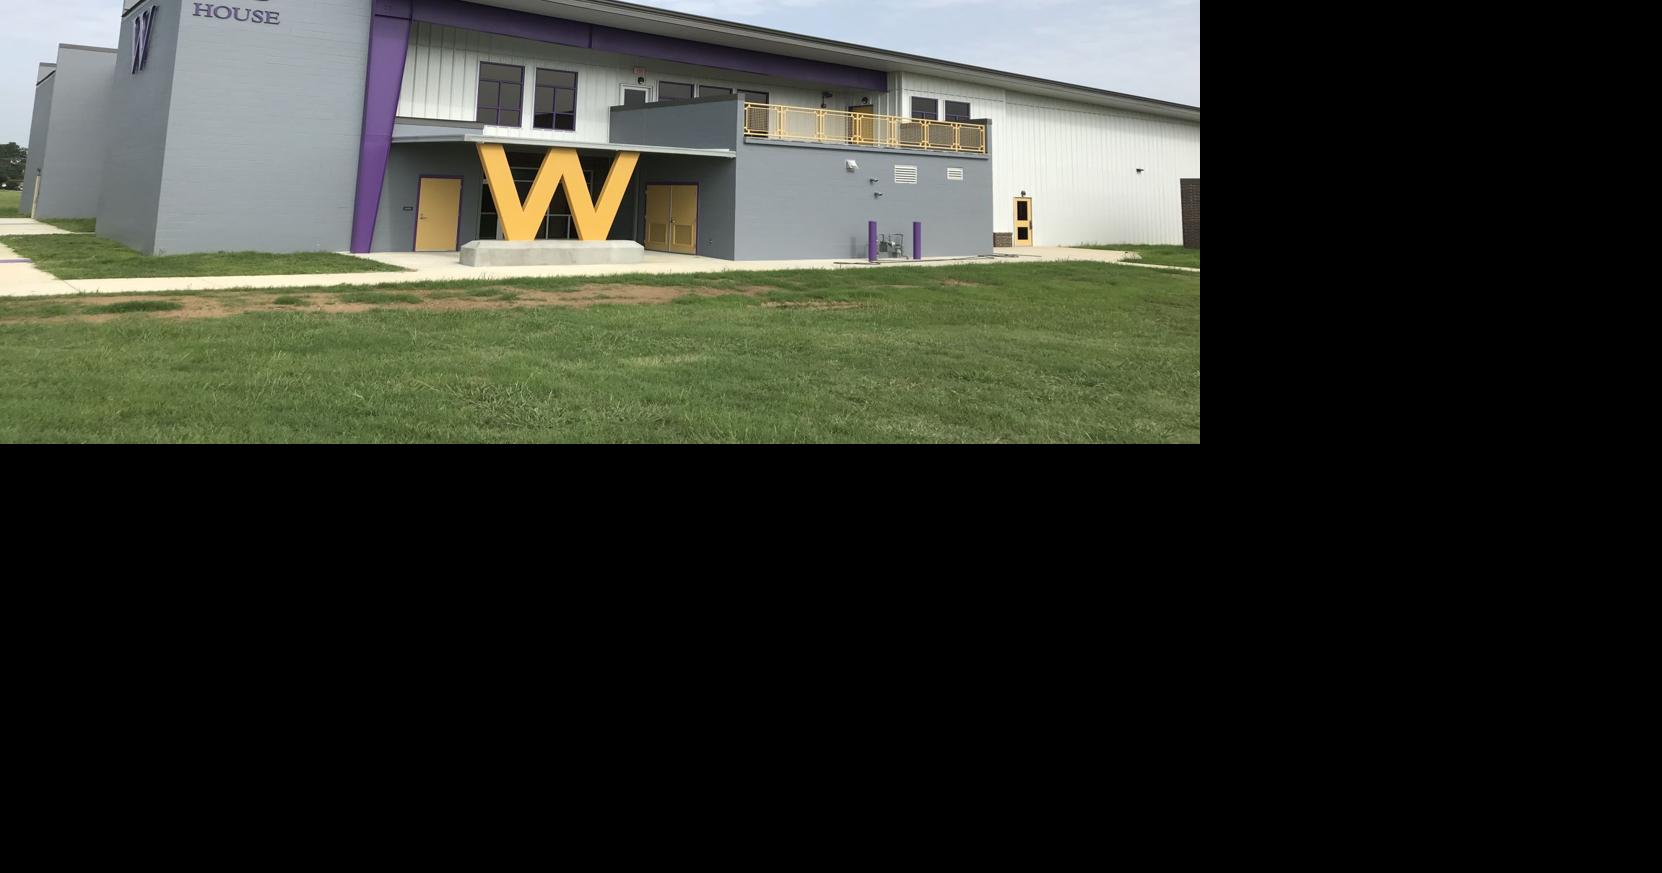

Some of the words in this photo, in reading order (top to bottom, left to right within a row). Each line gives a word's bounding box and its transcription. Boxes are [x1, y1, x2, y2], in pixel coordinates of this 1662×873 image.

[131, 5, 159, 74] W
[192, 2, 281, 25] HOUSE
[476, 143, 640, 241] W
